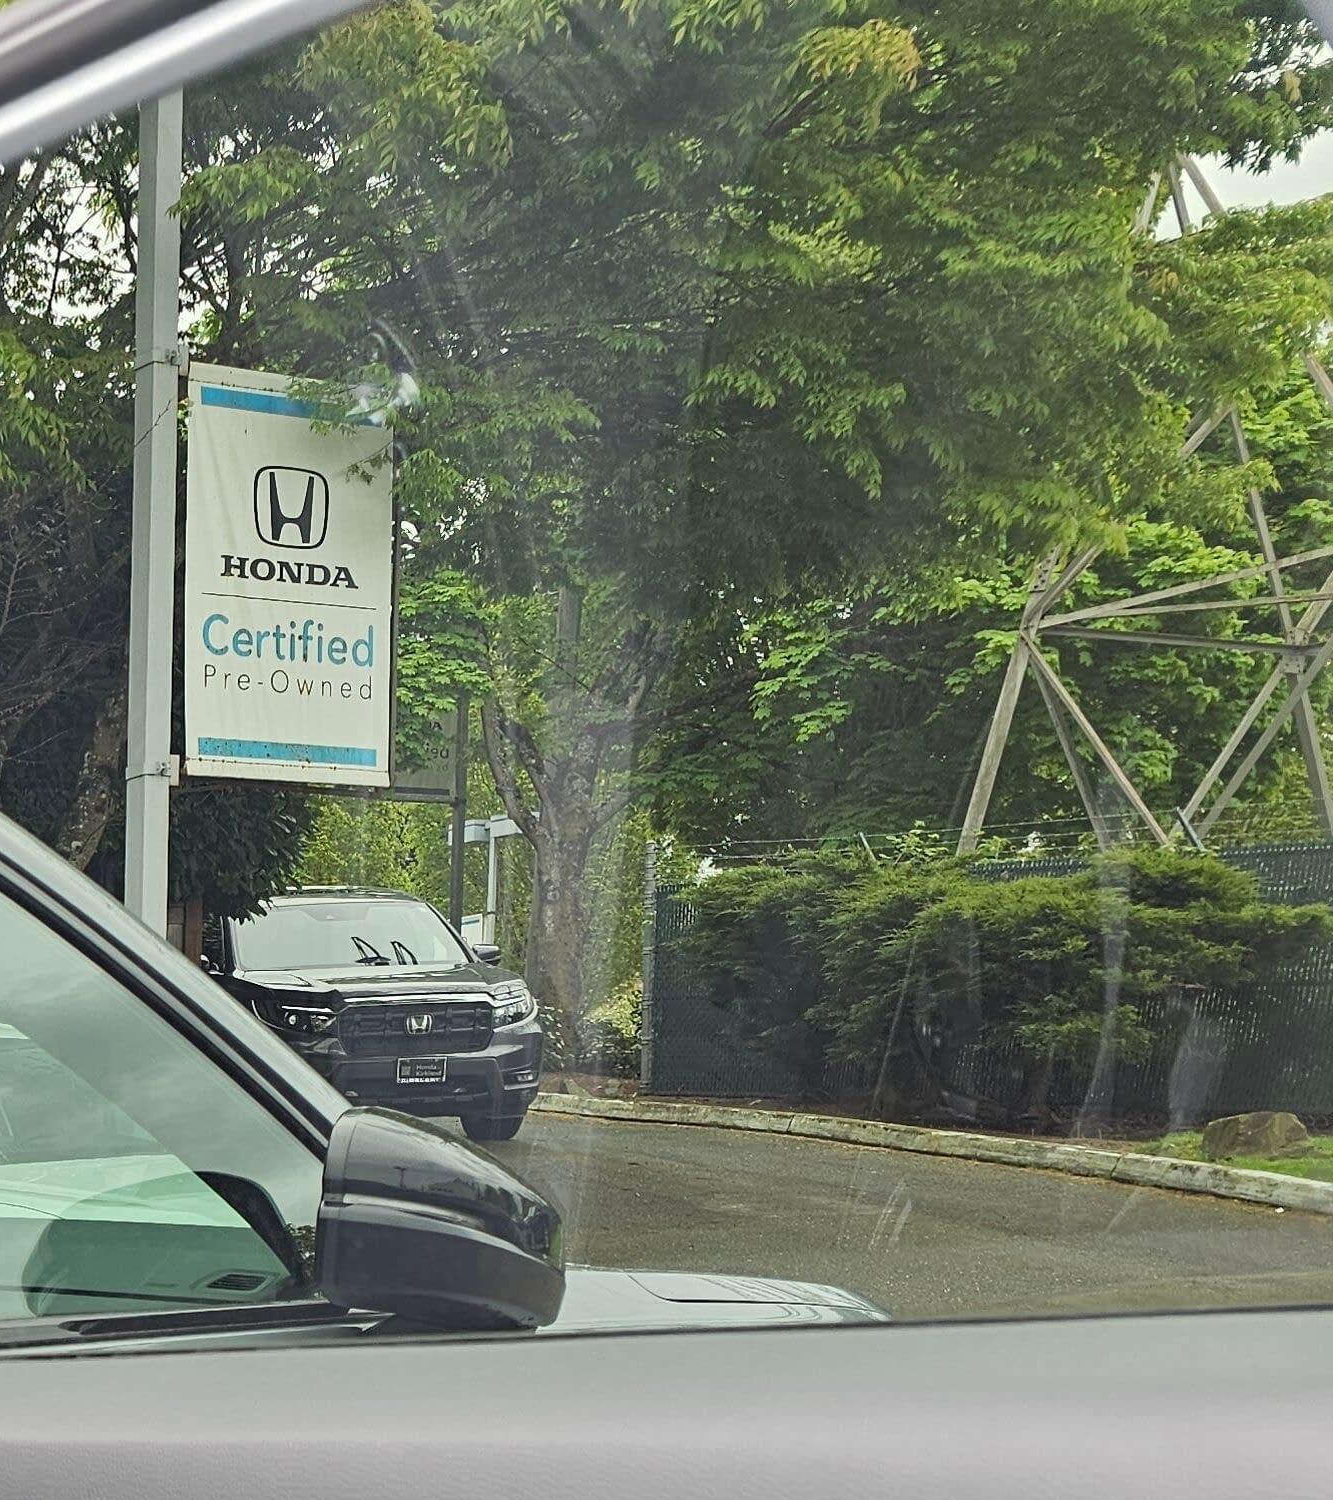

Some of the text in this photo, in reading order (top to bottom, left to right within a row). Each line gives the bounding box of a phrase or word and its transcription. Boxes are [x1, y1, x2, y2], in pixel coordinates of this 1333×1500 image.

[220, 554, 359, 590] HONDA
[201, 612, 374, 668] Certified
[203, 663, 373, 701] Pre-Owned
